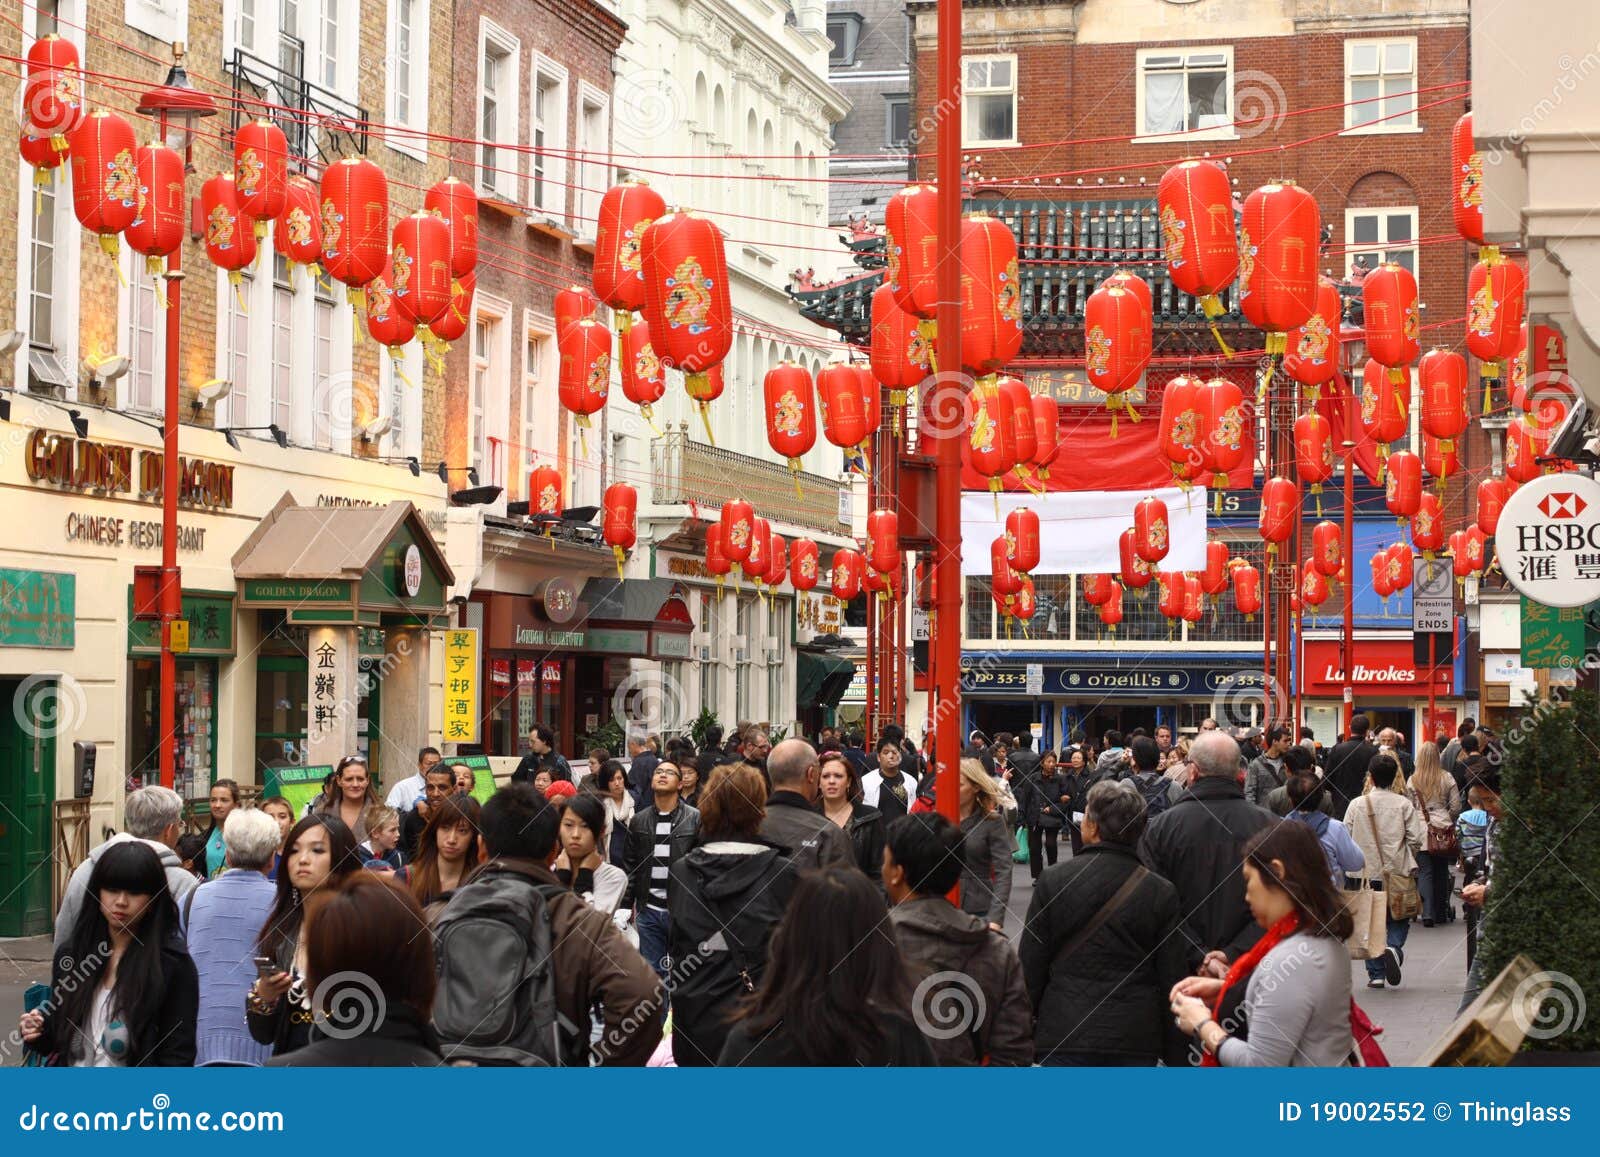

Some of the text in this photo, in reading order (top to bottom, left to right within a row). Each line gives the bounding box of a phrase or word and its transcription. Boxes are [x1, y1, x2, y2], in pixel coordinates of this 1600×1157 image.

[25, 428, 235, 509] GOLDEN DAGON
[66, 512, 207, 551] CHINESE RESTARANT
[1516, 523, 1600, 552] HSBC
[256, 586, 340, 597] GOLDEN DRAGON
[1418, 620, 1449, 629] ENDS
[448, 632, 470, 738] 翠亨邨酒家
[997, 673, 1026, 684] 33-3
